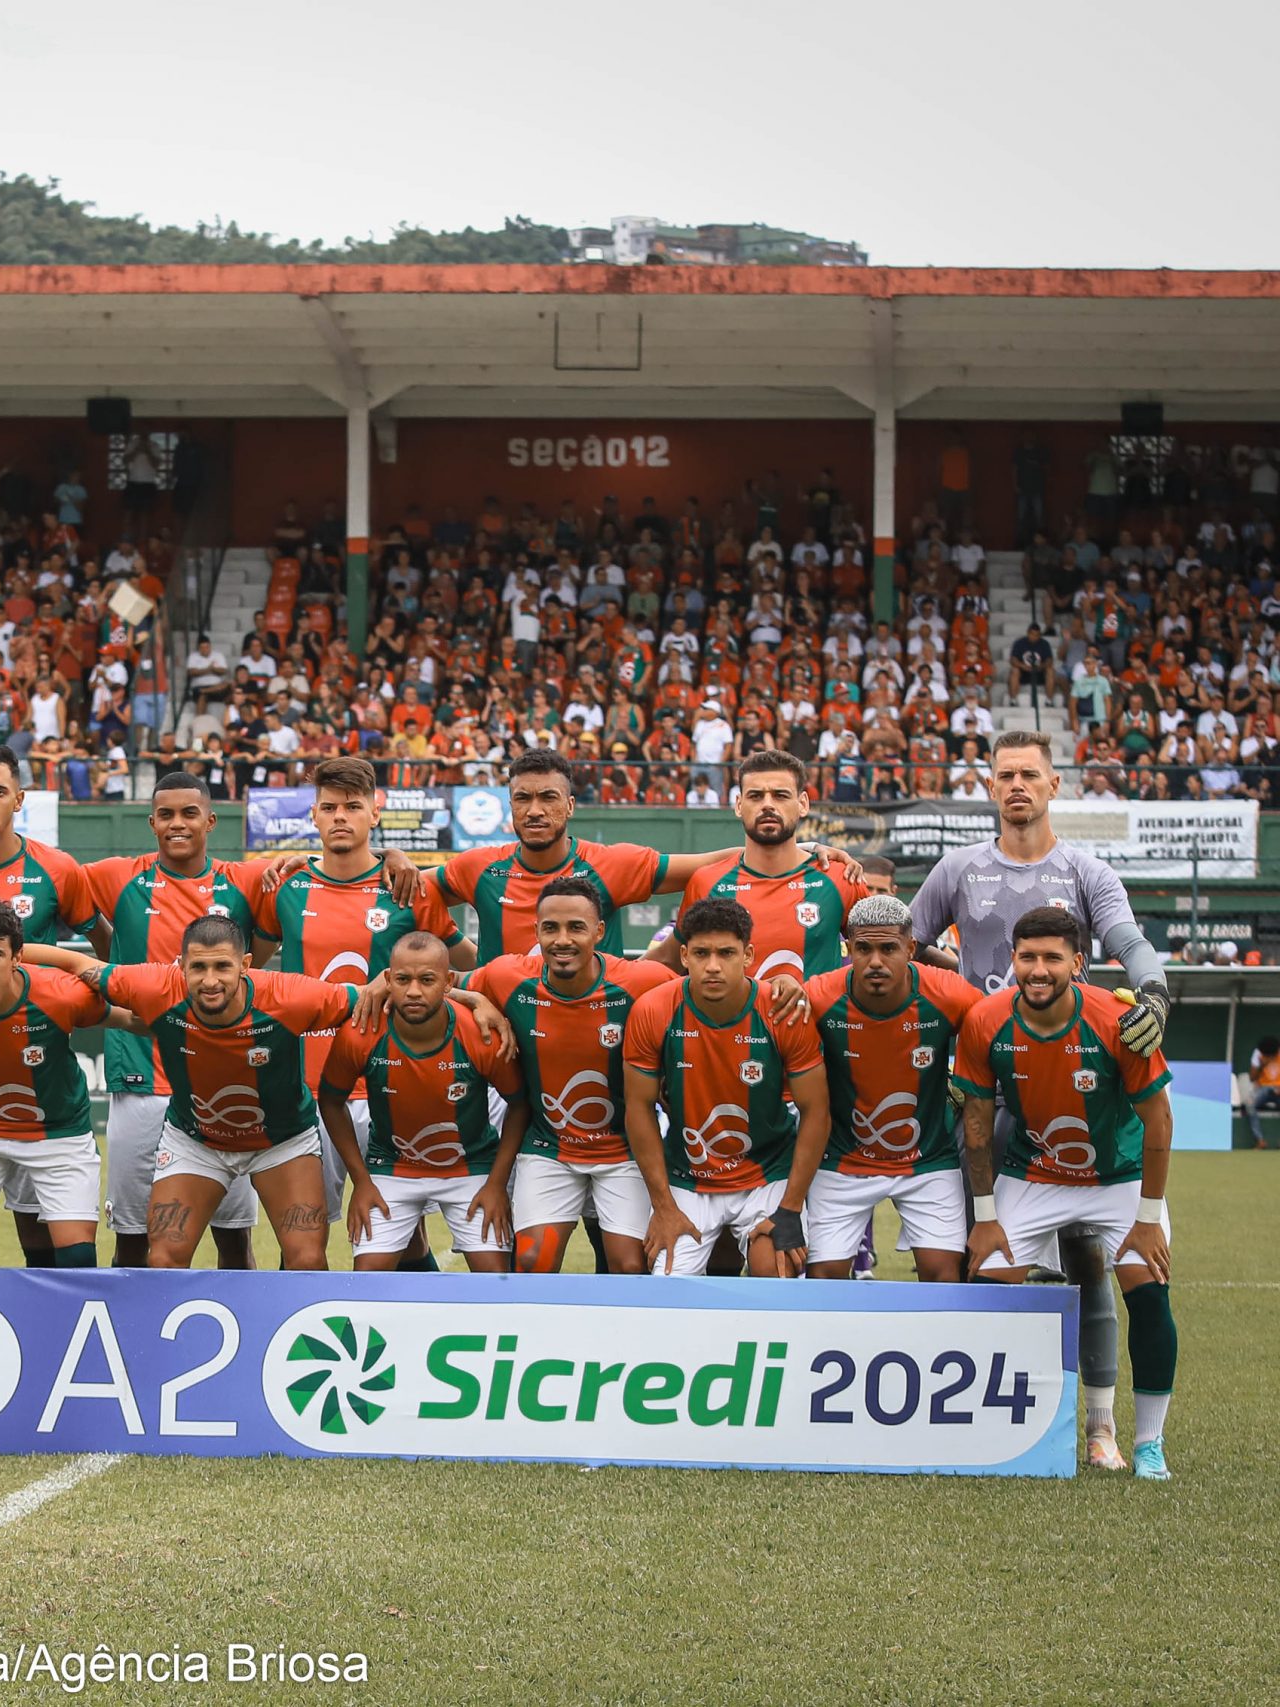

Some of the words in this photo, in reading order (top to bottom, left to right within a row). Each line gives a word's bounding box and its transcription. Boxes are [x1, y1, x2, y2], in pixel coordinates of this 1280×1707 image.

[36, 1298, 239, 1436] A2
[418, 1338, 788, 1428] Sicredi
[810, 1349, 1036, 1425] 2024
